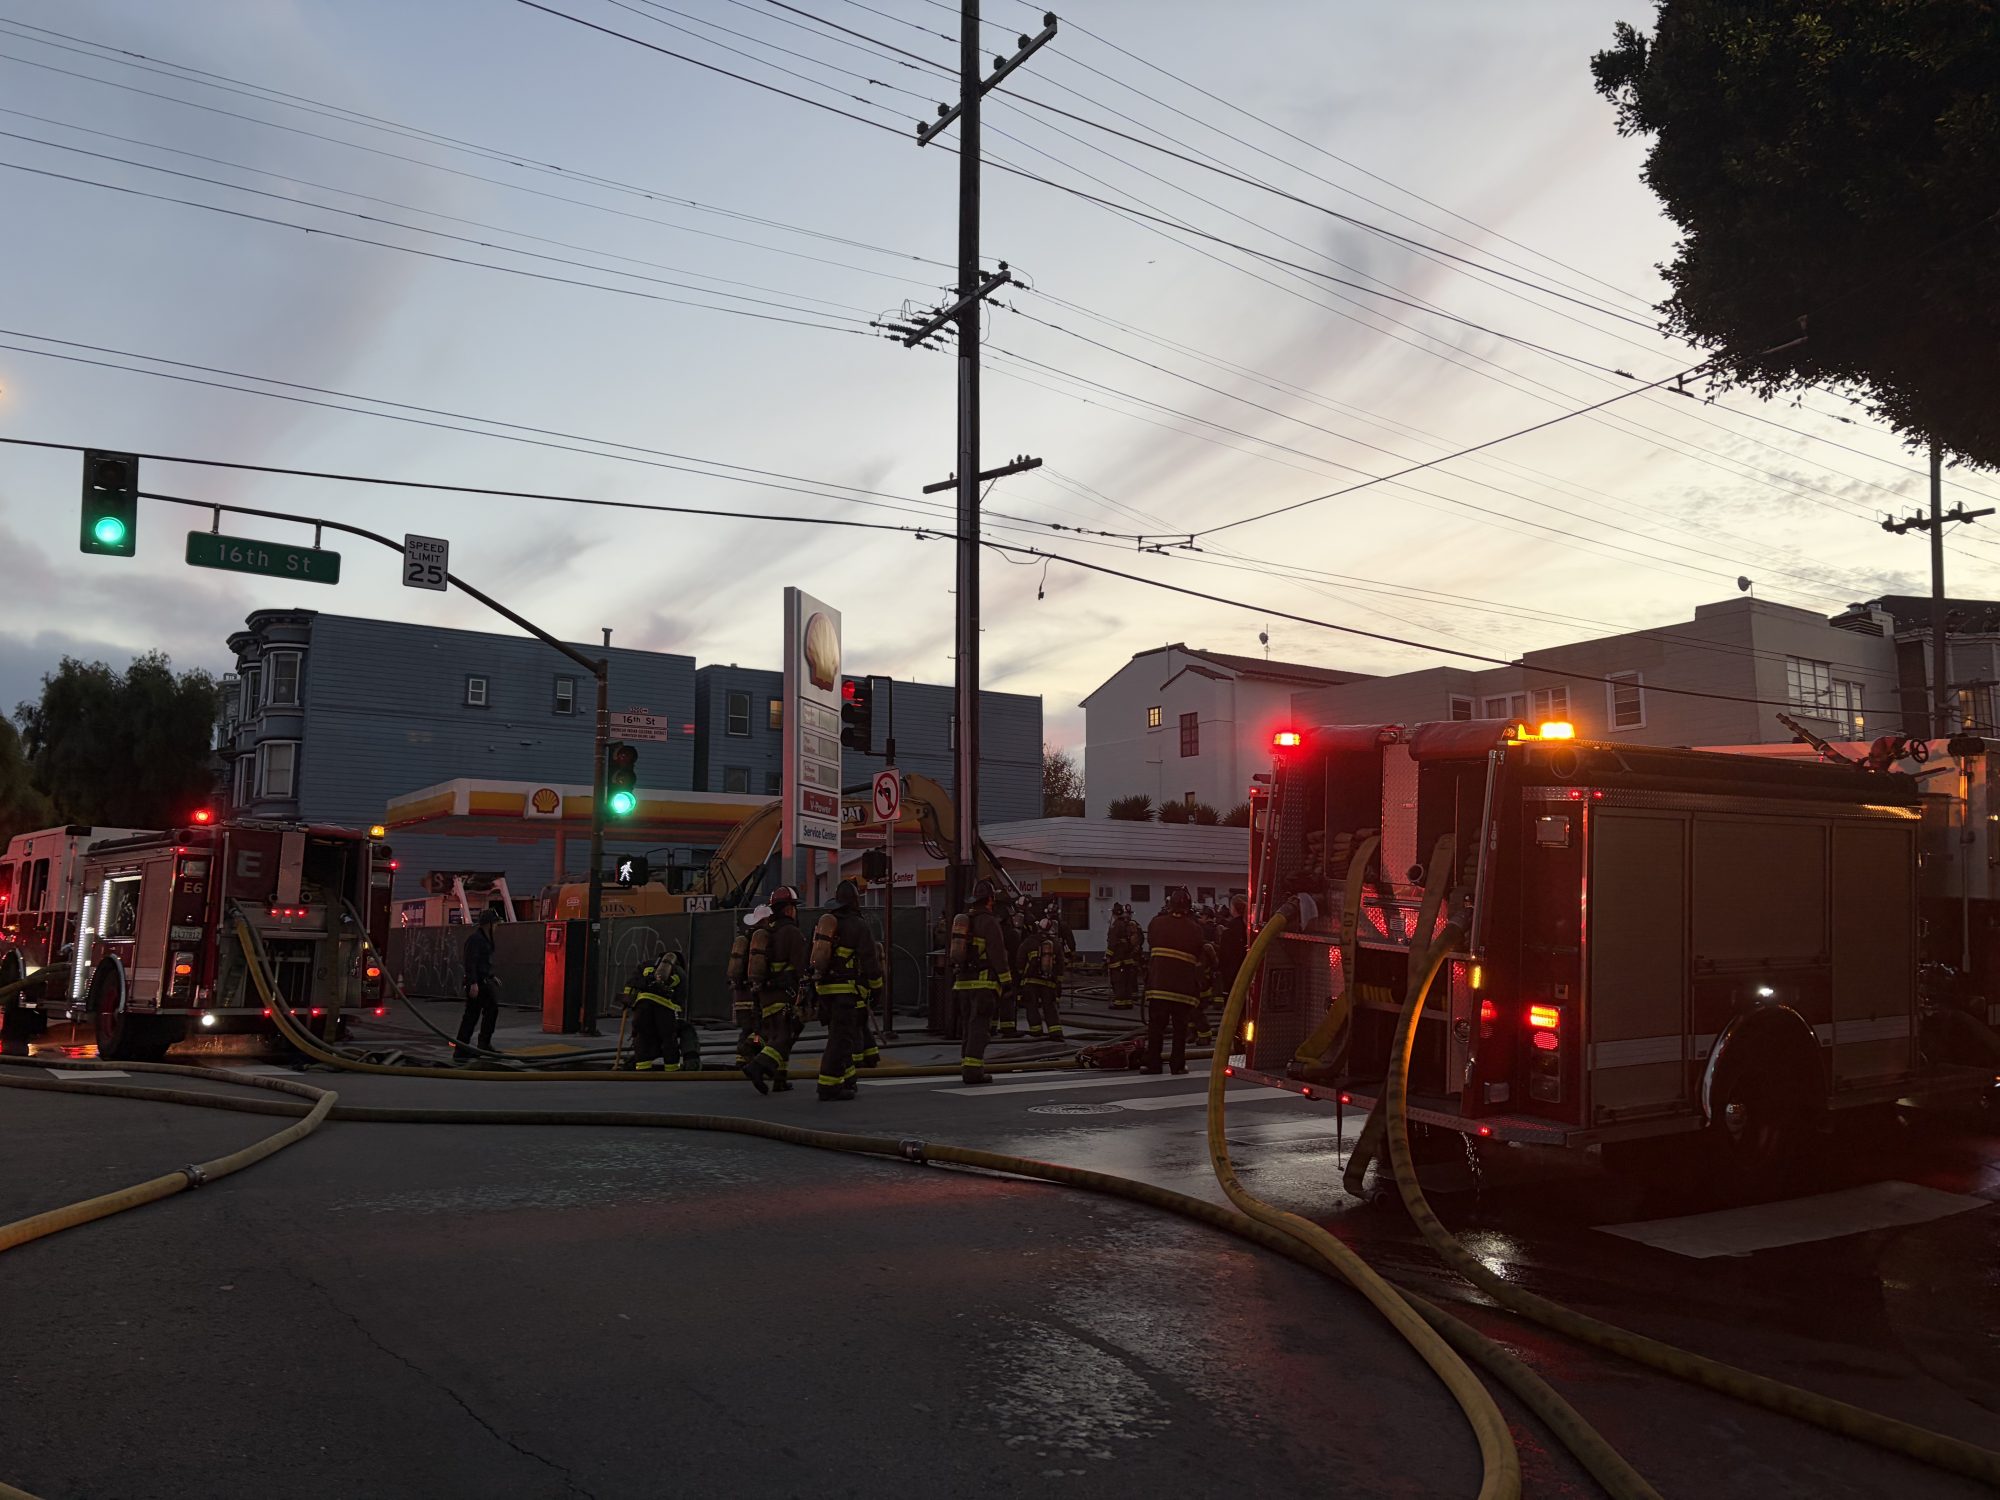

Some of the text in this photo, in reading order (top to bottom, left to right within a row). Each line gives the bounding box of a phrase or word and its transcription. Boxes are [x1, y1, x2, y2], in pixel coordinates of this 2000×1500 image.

[409, 540, 445, 553] SPEED
[219, 544, 311, 573] 16th St
[411, 551, 441, 563] LIMIT
[408, 562, 443, 585] 25
[623, 715, 656, 726] 16th St
[841, 806, 862, 824] CAT
[803, 824, 837, 841] Service Center
[237, 849, 263, 878] E
[893, 872, 914, 882] Center
[183, 882, 204, 894] E6
[1020, 880, 1038, 892] Mart
[686, 897, 713, 913] CAT
